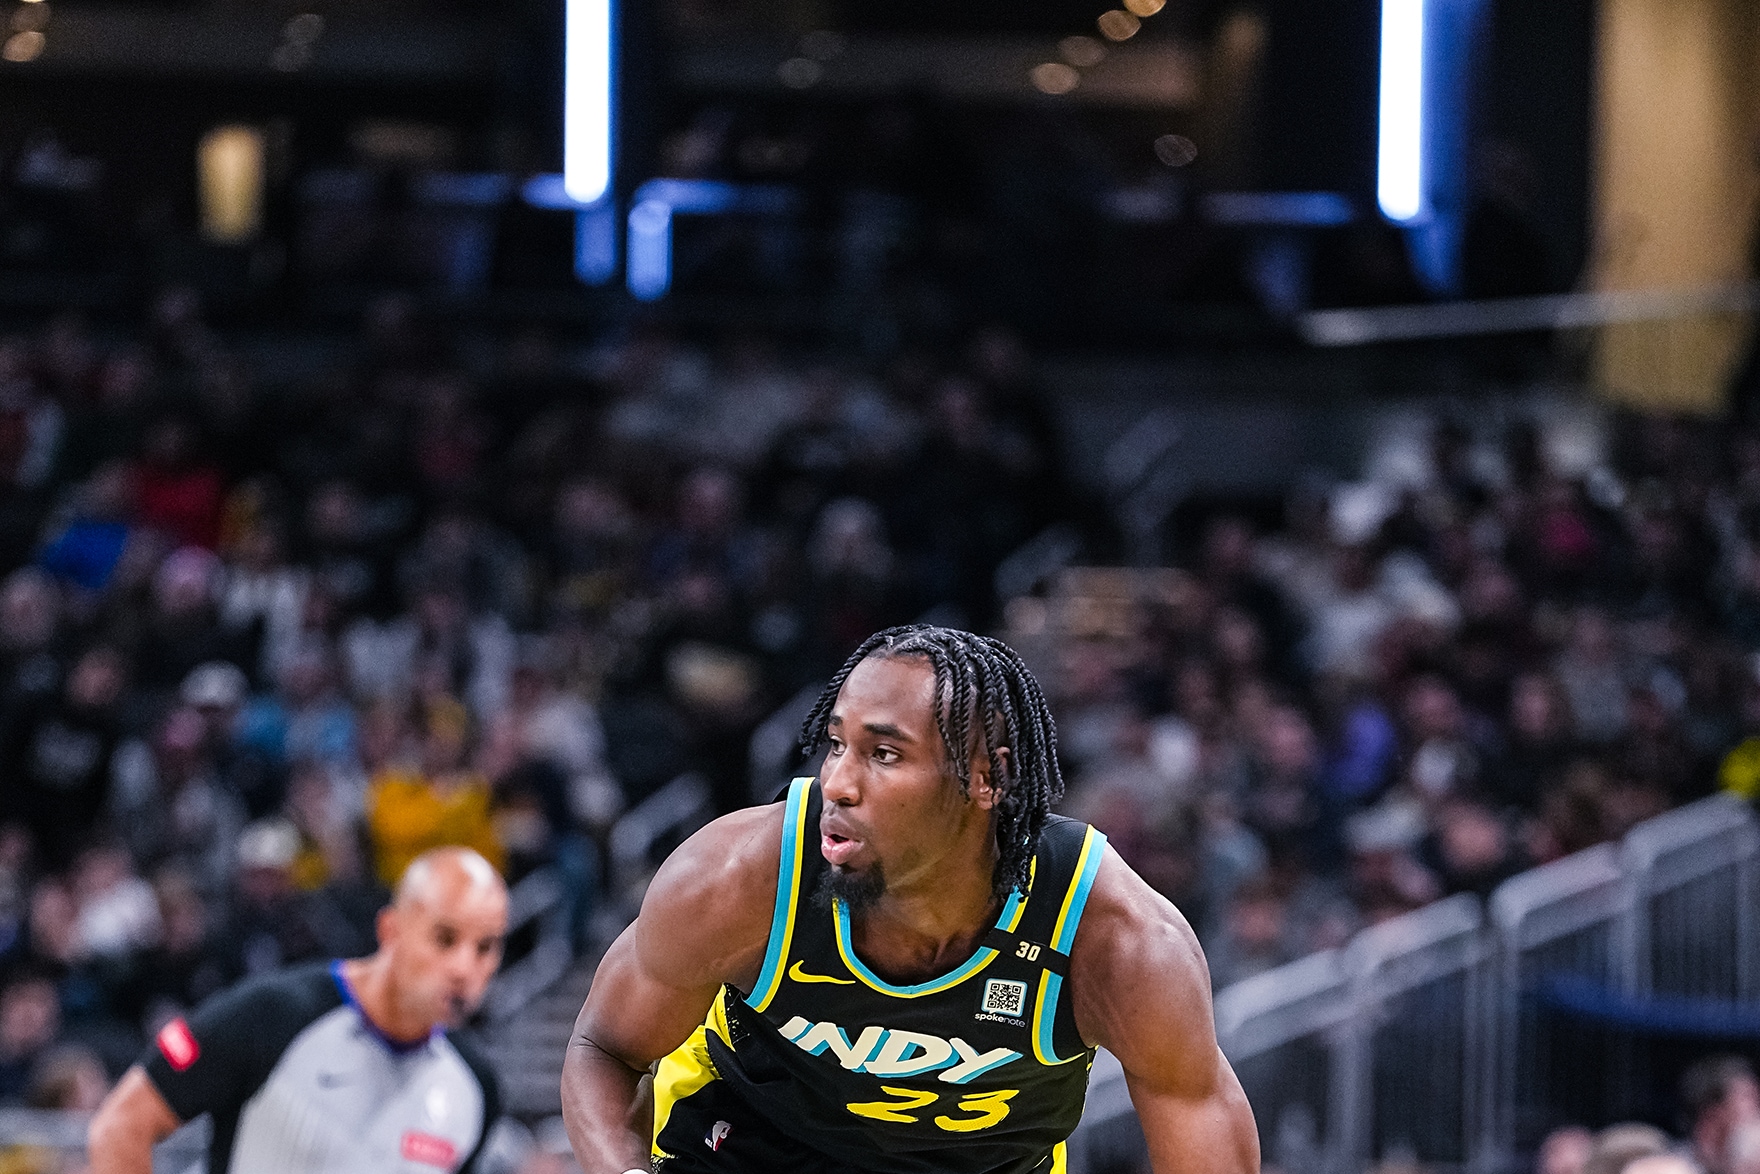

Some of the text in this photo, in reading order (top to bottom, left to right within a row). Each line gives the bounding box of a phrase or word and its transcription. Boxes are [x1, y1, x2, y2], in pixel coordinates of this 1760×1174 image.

[1015, 941, 1041, 962] 30
[974, 1013, 1026, 1028] spokenote
[778, 1016, 1023, 1084] INDY
[846, 1086, 1019, 1132] 23
